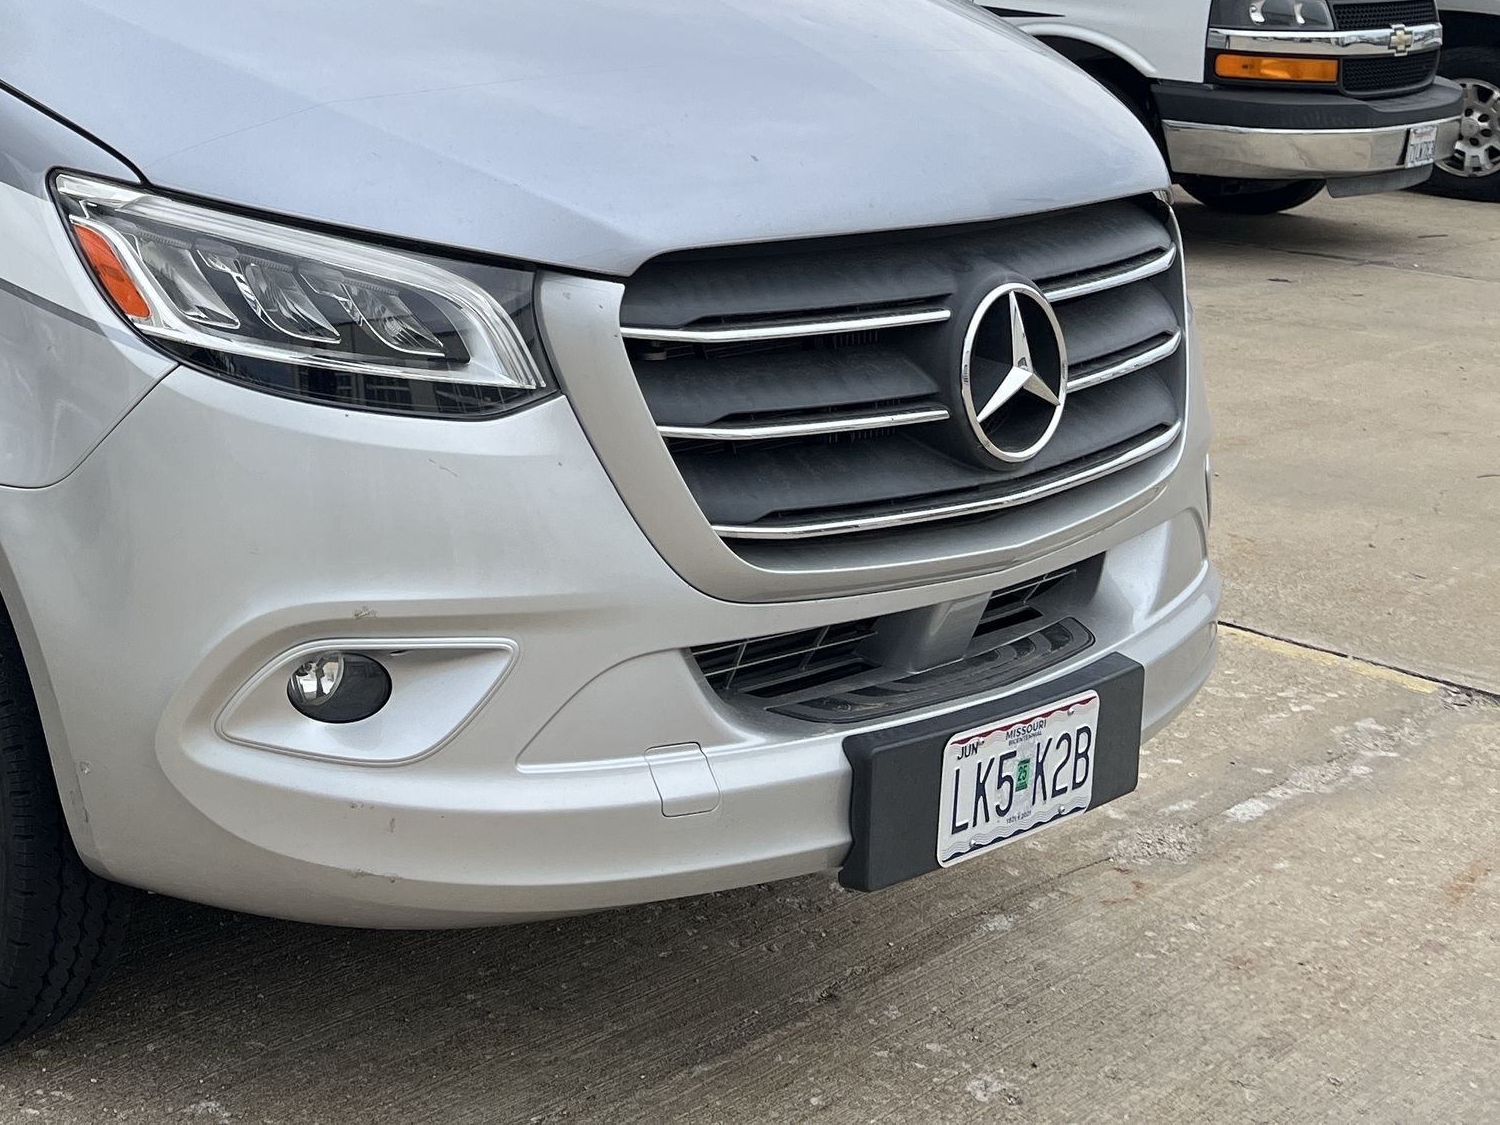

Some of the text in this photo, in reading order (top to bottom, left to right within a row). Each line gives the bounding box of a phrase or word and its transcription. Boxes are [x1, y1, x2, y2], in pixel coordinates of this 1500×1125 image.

[1005, 719, 1047, 741] MISSOURI
[1008, 731, 1043, 746] BICENTENNIAL
[957, 742, 979, 761] JUN
[951, 725, 1092, 835] LK5 K2B
[1017, 764, 1028, 782] 25
